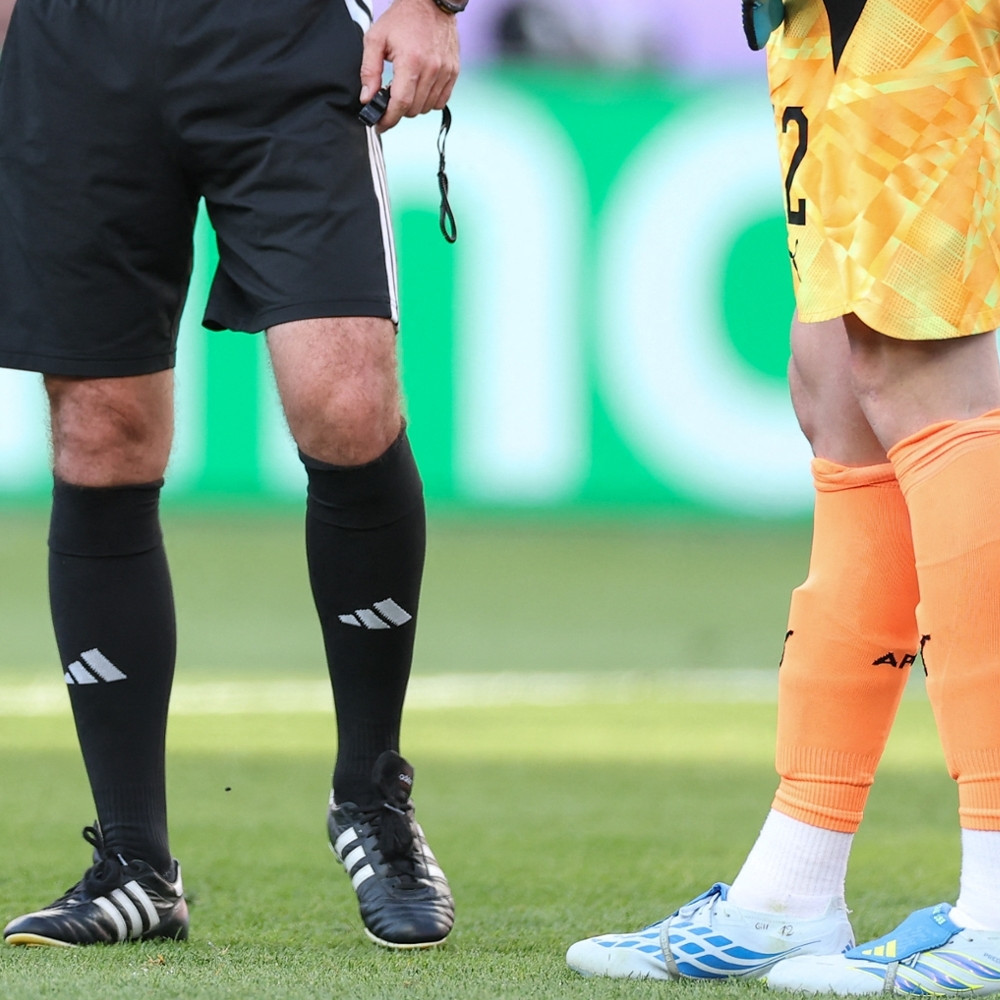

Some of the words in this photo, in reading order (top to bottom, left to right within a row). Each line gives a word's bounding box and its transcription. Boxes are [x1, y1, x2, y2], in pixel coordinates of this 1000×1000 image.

[772, 104, 809, 226] 2
[872, 652, 917, 669] AP
[780, 924, 795, 937] 12
